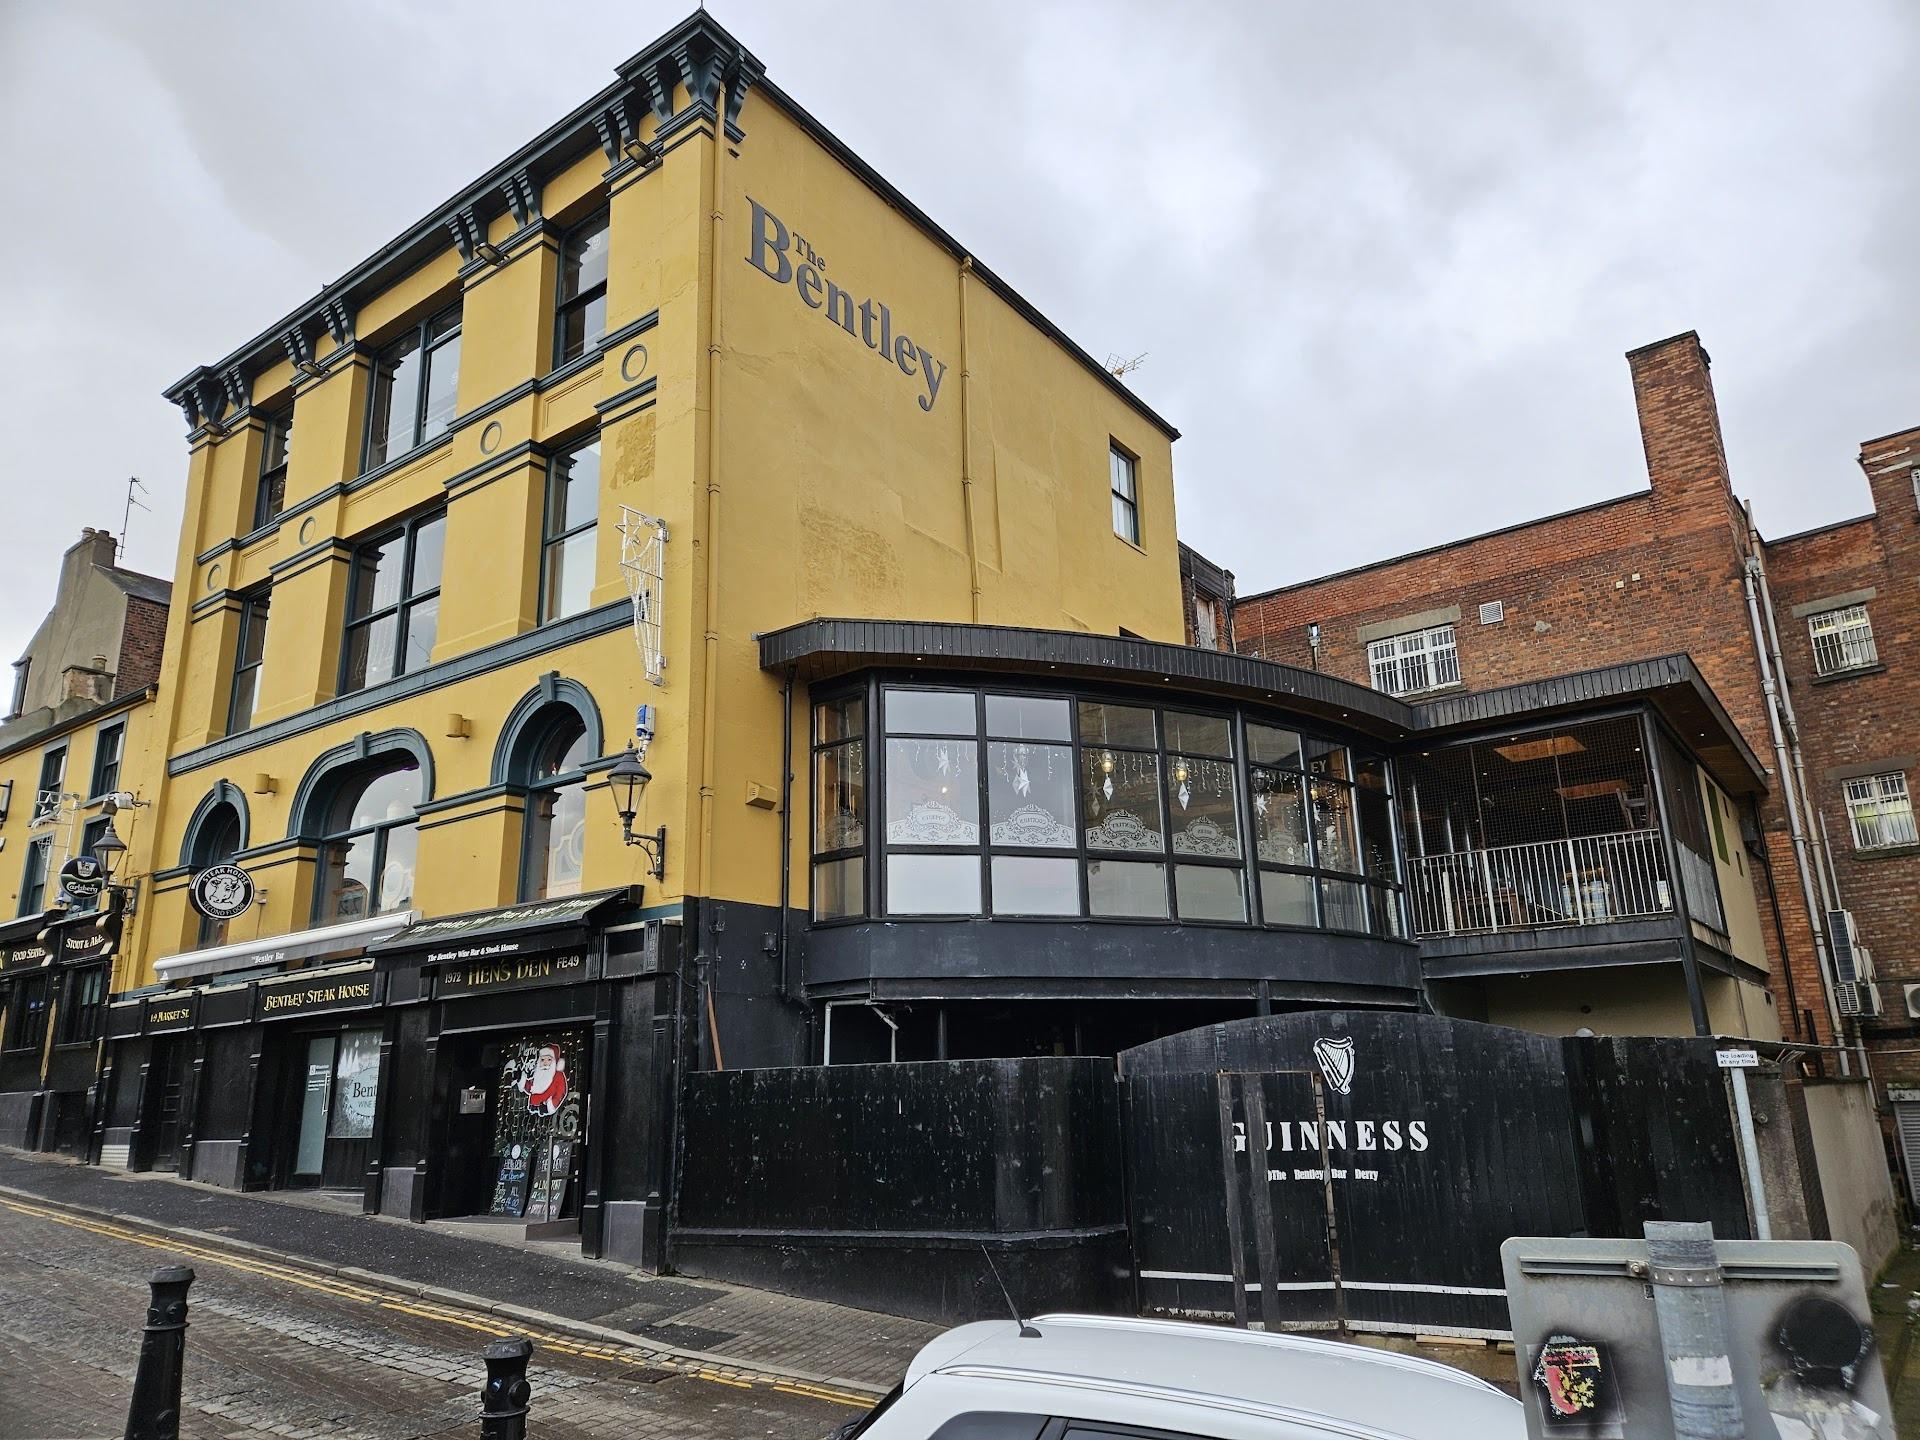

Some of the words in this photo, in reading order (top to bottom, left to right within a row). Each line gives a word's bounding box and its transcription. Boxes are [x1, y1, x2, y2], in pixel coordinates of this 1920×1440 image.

[793, 232, 826, 271] The
[745, 196, 947, 412] Bentley
[656, 856, 661, 864] 3
[203, 868, 225, 882] STEAK
[227, 868, 249, 885] HOUSE
[66, 882, 98, 894] Carlsberg
[202, 901, 225, 915] SECOND
[226, 903, 245, 915] FLOOR
[65, 938, 84, 950] STOUT
[84, 939, 89, 948] &
[11, 950, 27, 962] FOOD
[26, 947, 46, 959] SERVE
[275, 952, 285, 960] Bar
[427, 954, 437, 962] The
[437, 952, 457, 961] Bentley
[470, 949, 480, 957] Bar
[485, 945, 500, 954] Steak
[500, 943, 519, 952] House
[445, 972, 461, 984] 1972
[516, 958, 550, 979] DEN
[556, 955, 580, 969] FE49
[263, 992, 305, 1011] BENTLEY
[306, 988, 335, 1004] STEAK
[338, 983, 370, 1000] HOUSE
[157, 1010, 181, 1022] MARKET
[1293, 1168, 1324, 1181] Bentley
[1331, 1168, 1347, 1179] Bar
[1355, 1168, 1379, 1182] Derry
